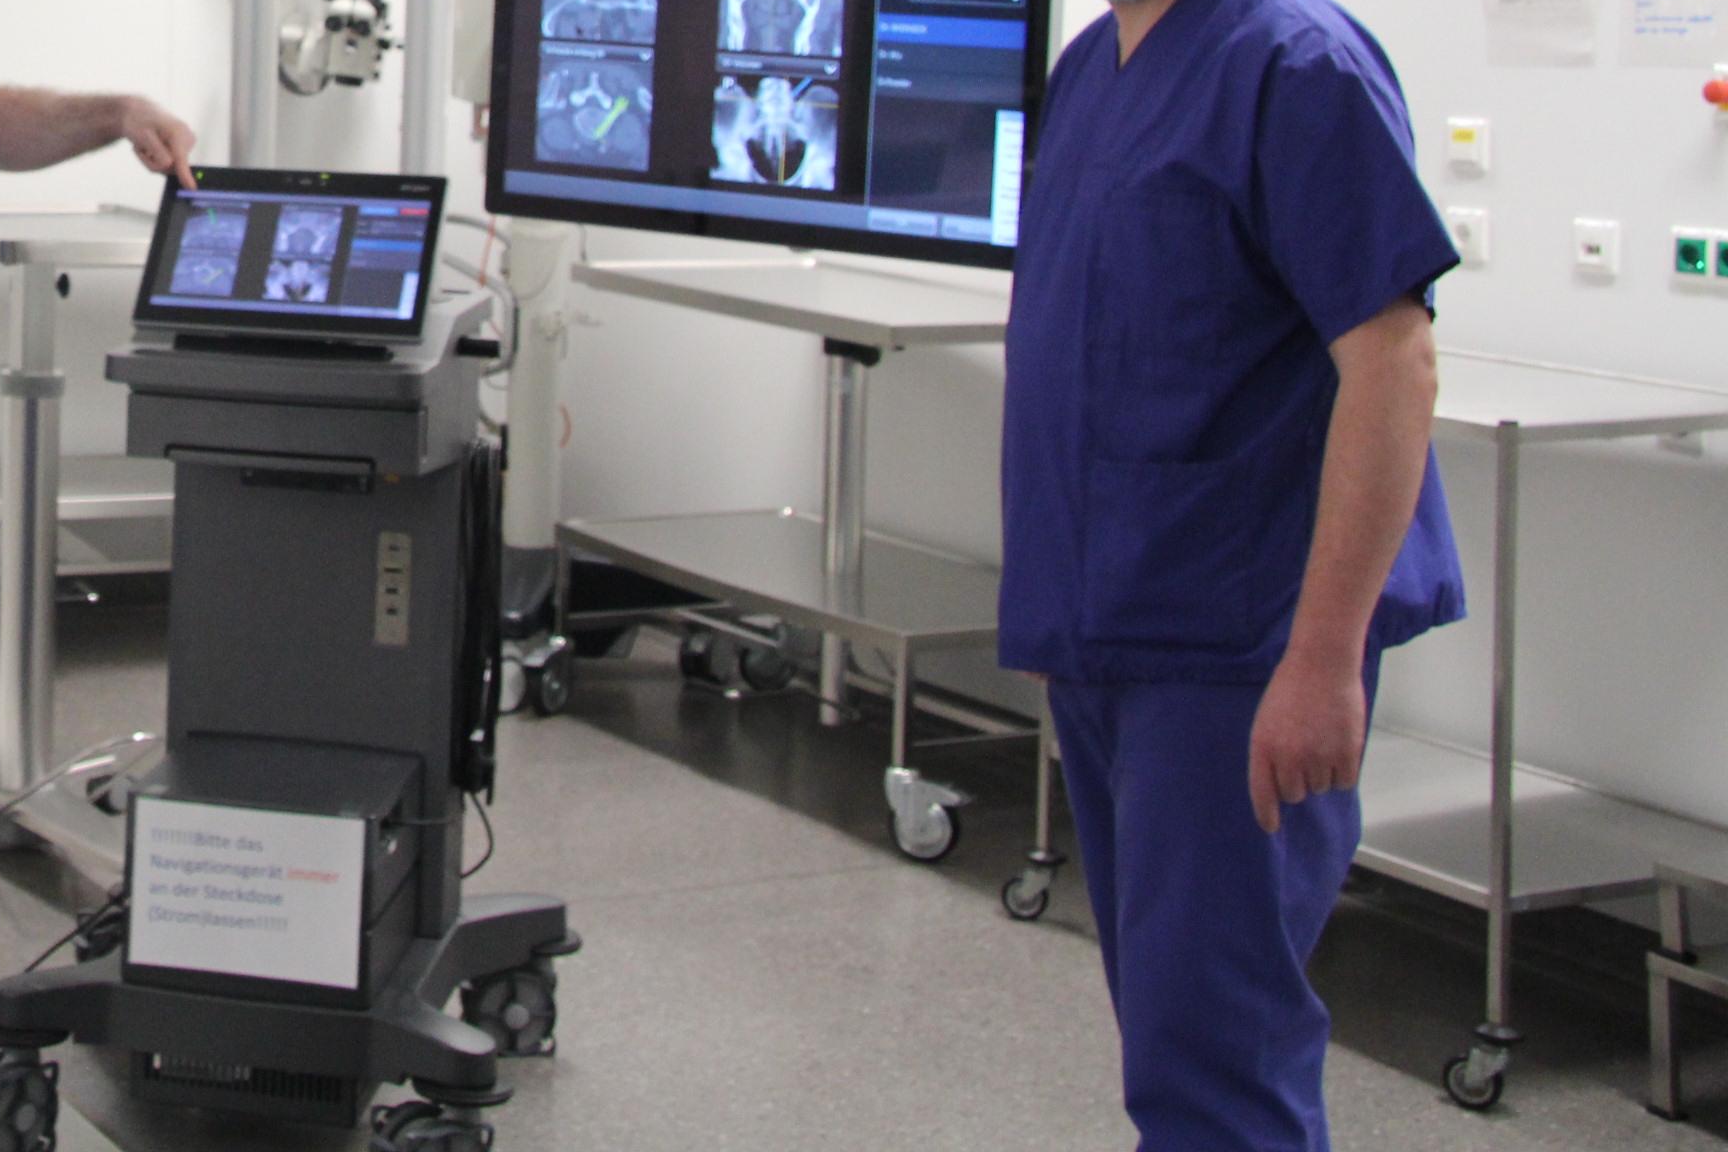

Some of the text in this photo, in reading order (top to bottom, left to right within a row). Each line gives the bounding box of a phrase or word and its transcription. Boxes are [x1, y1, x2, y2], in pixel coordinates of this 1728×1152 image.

[150, 854, 283, 880] Navigationsgerät
[172, 882, 198, 899] der
[203, 884, 283, 905] Steckdose
